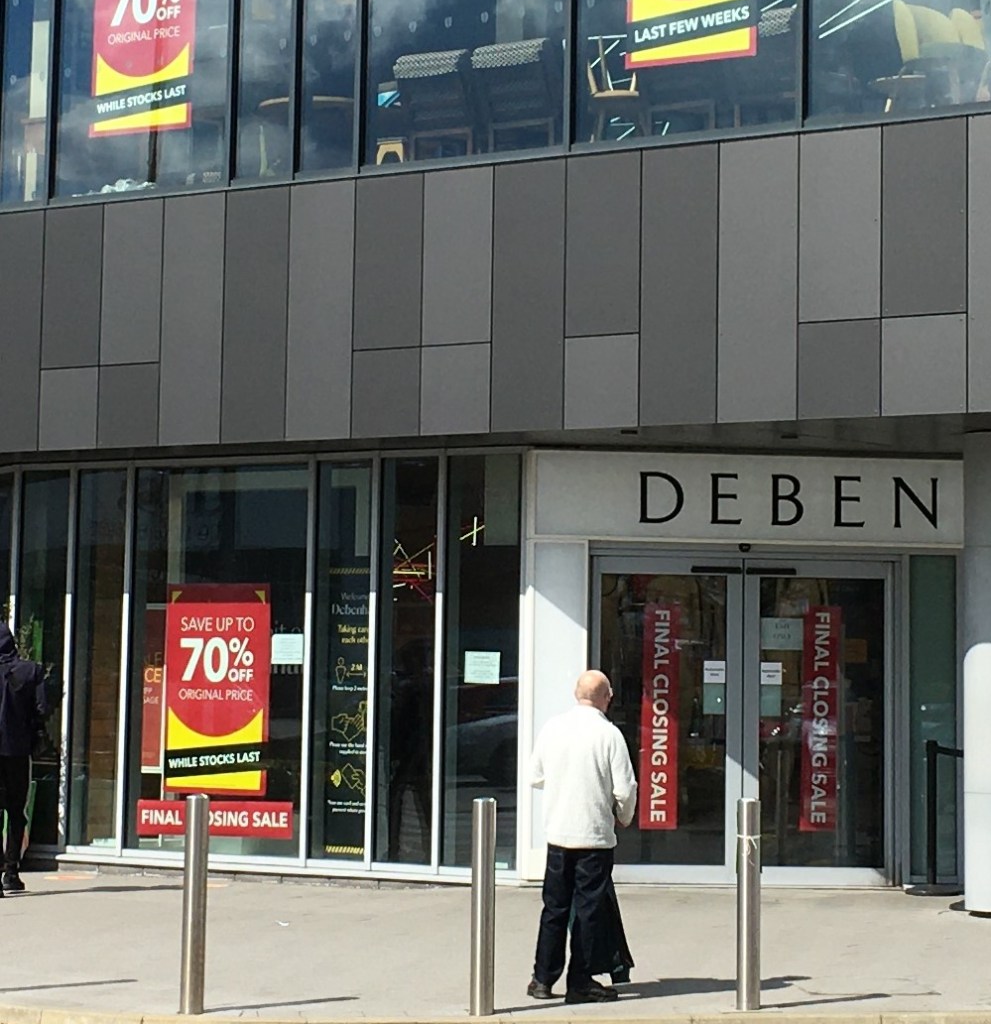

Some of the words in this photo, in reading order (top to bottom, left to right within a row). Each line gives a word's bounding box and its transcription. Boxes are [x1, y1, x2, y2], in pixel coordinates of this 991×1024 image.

[156, 5, 181, 21] OFF
[634, 23, 667, 43] LAST
[669, 16, 699, 36] FEW
[700, 5, 750, 28] WEEKS
[107, 30, 152, 45] ORIGINAL
[153, 25, 181, 40] PRICE
[96, 97, 126, 114] WHILE
[126, 89, 163, 108] STOCKS
[164, 84, 187, 99] LAST
[180, 616, 213, 632] SAVE
[216, 616, 234, 632] UP
[237, 616, 255, 632] TO
[331, 603, 370, 615] Debenh
[653, 609, 671, 670] FINAL
[813, 611, 831, 672] FINAL
[180, 636, 254, 684] 70%
[228, 668, 254, 683] OFF
[178, 688, 224, 702] ORIGINAL
[225, 689, 253, 702] PRICE
[651, 674, 669, 767] CLOSING
[811, 675, 830, 768] CLOSING
[168, 756, 198, 769] WHILE
[199, 752, 236, 766] STOCKS
[236, 751, 261, 763] LAST
[650, 772, 668, 823] SALE
[810, 774, 828, 824] SALE
[141, 809, 183, 825] FINAL
[208, 811, 249, 827] SING
[252, 811, 289, 828] SALE
